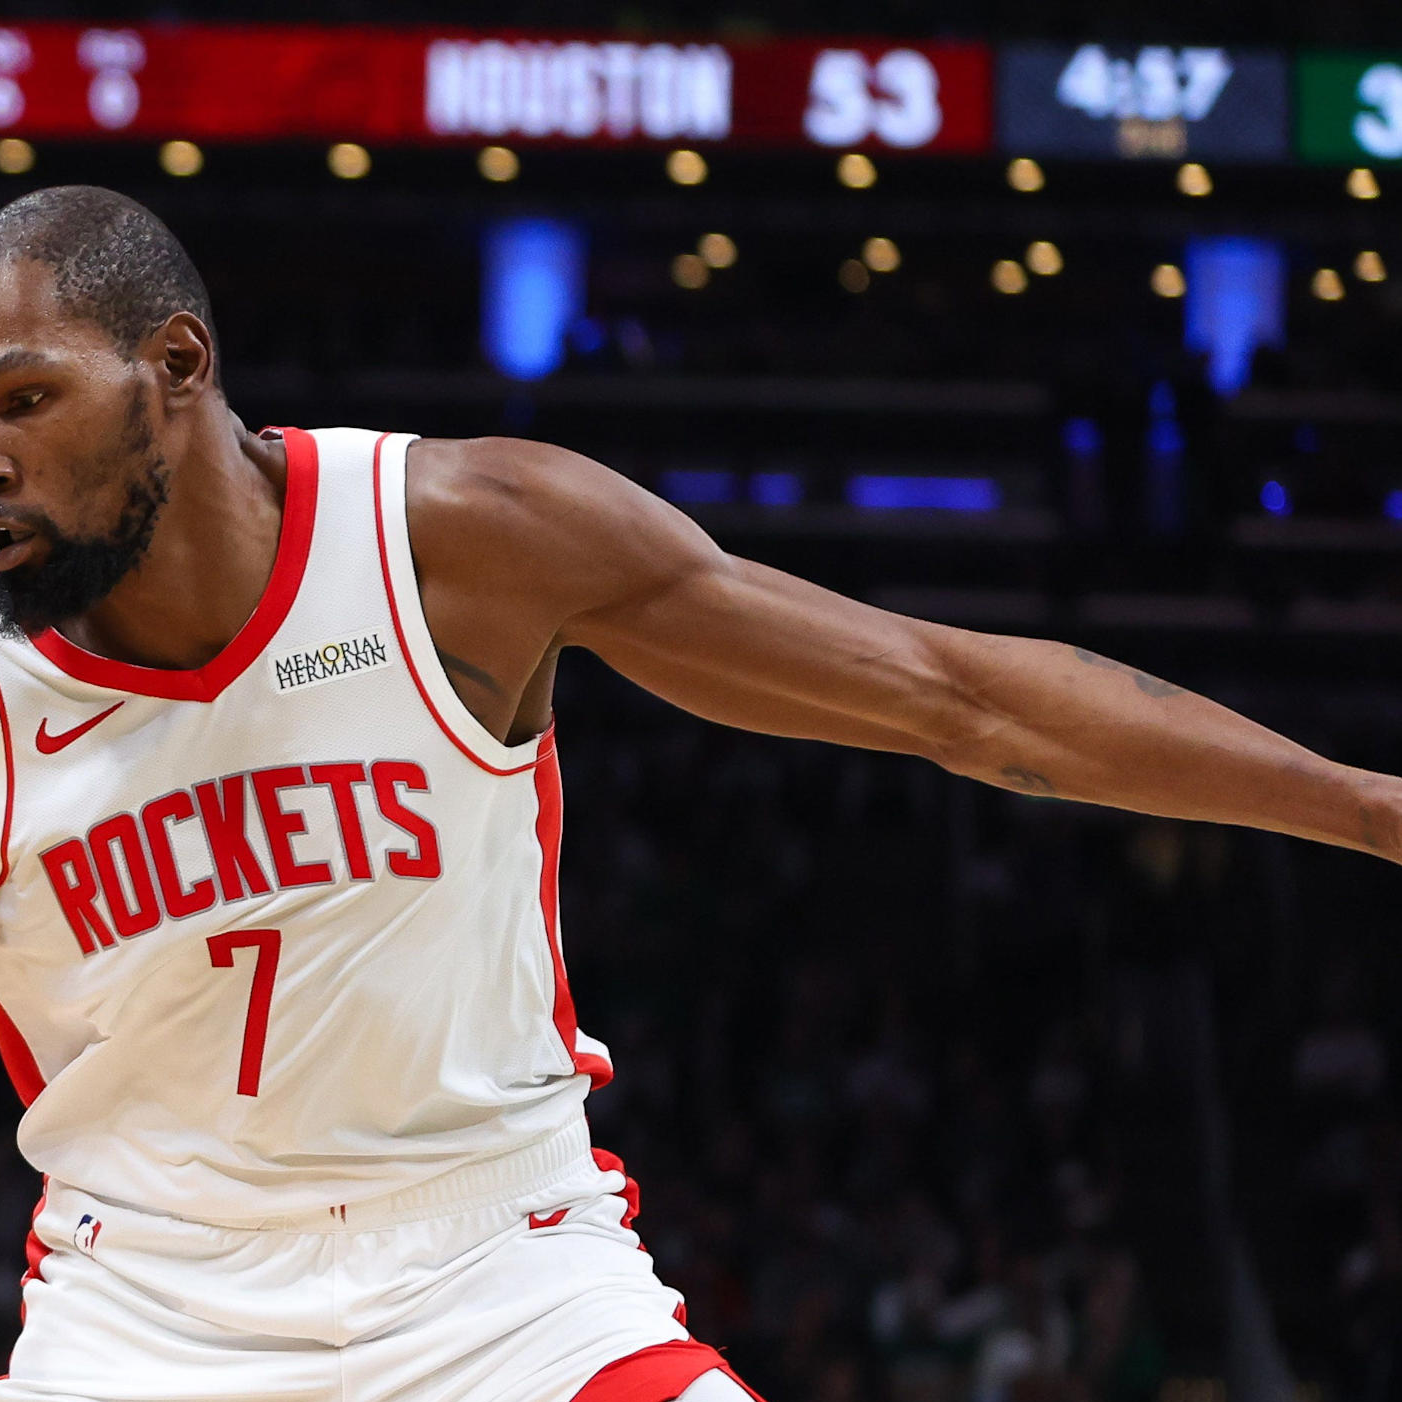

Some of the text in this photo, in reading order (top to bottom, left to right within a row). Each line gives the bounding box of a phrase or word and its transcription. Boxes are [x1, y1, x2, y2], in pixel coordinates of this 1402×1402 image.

[426, 40, 943, 149] HOUSTON 53
[276, 633, 386, 677] MEMORIAL
[278, 648, 387, 690] HERMANN
[38, 759, 444, 958] ROCKETS
[206, 928, 282, 1098] 7
